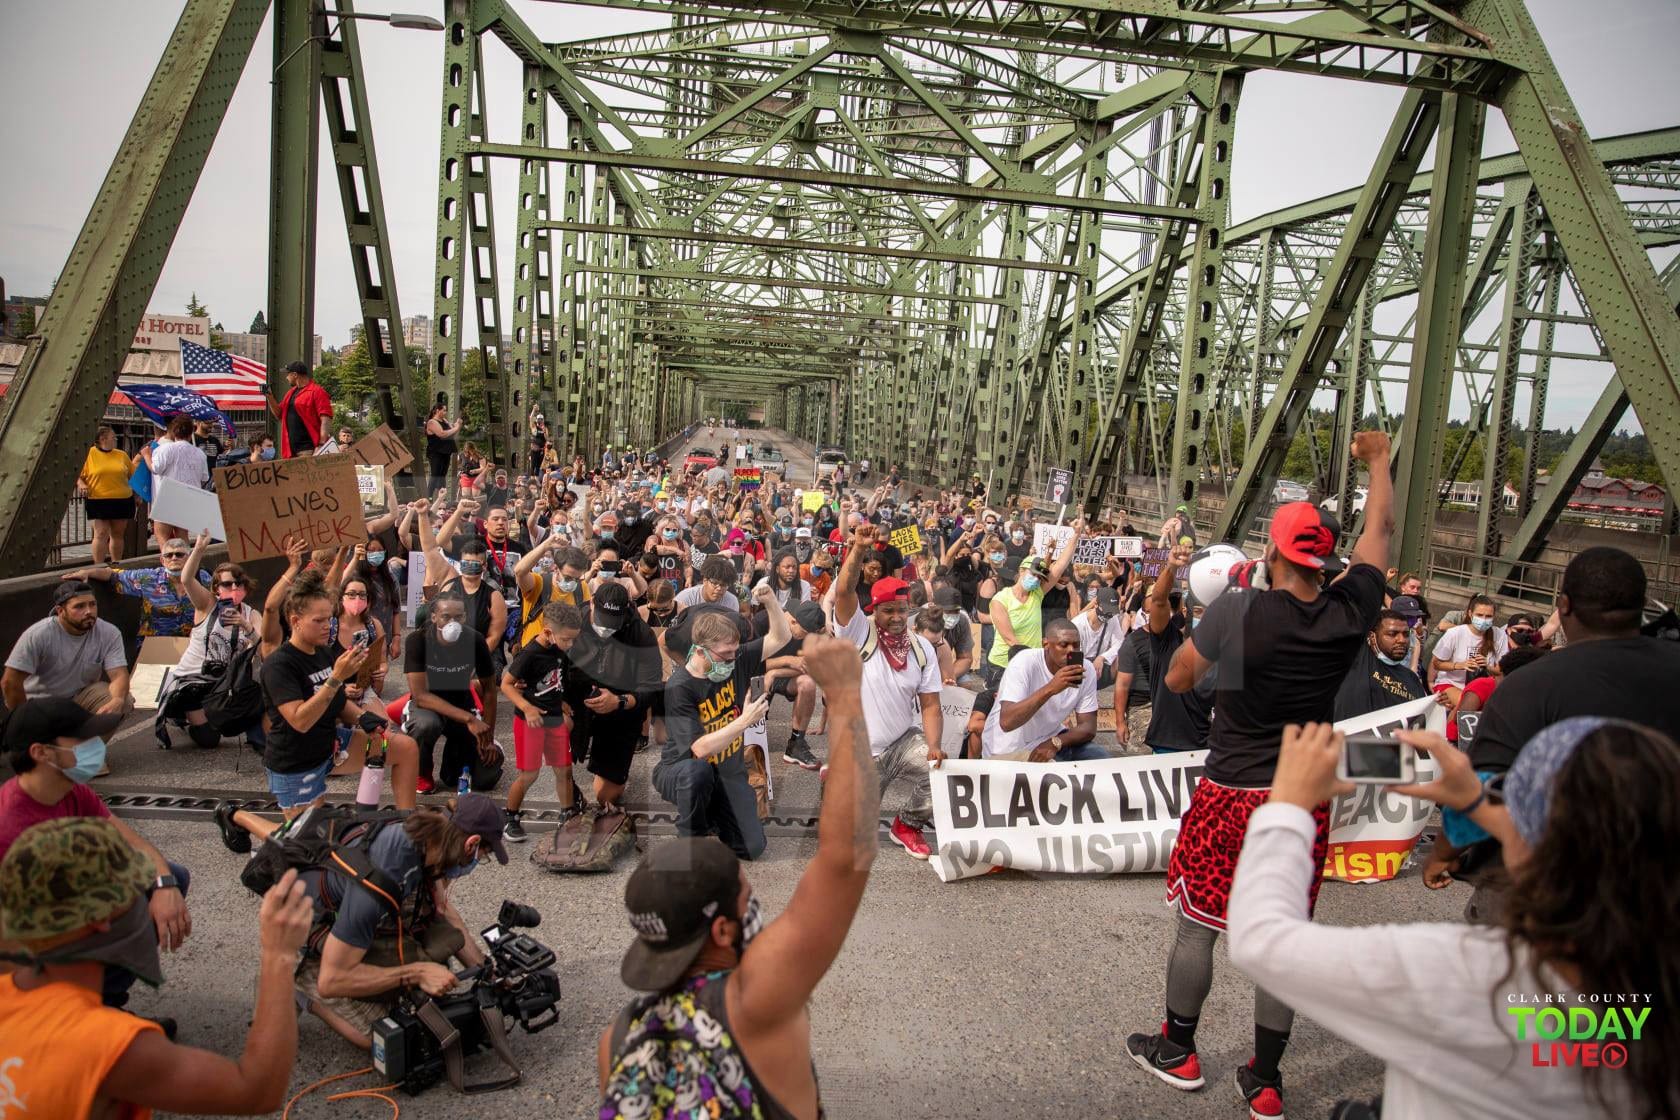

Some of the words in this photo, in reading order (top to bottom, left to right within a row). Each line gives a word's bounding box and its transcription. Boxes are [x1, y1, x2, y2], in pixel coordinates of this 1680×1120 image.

[224, 462, 289, 490] Black
[1072, 556, 1108, 566] ATTER
[1077, 539, 1106, 549] LACK
[698, 679, 737, 723] BLACK
[947, 772, 1105, 829] BLACK
[1112, 764, 1206, 822] LIVE
[1036, 828, 1180, 873] JUSTIC
